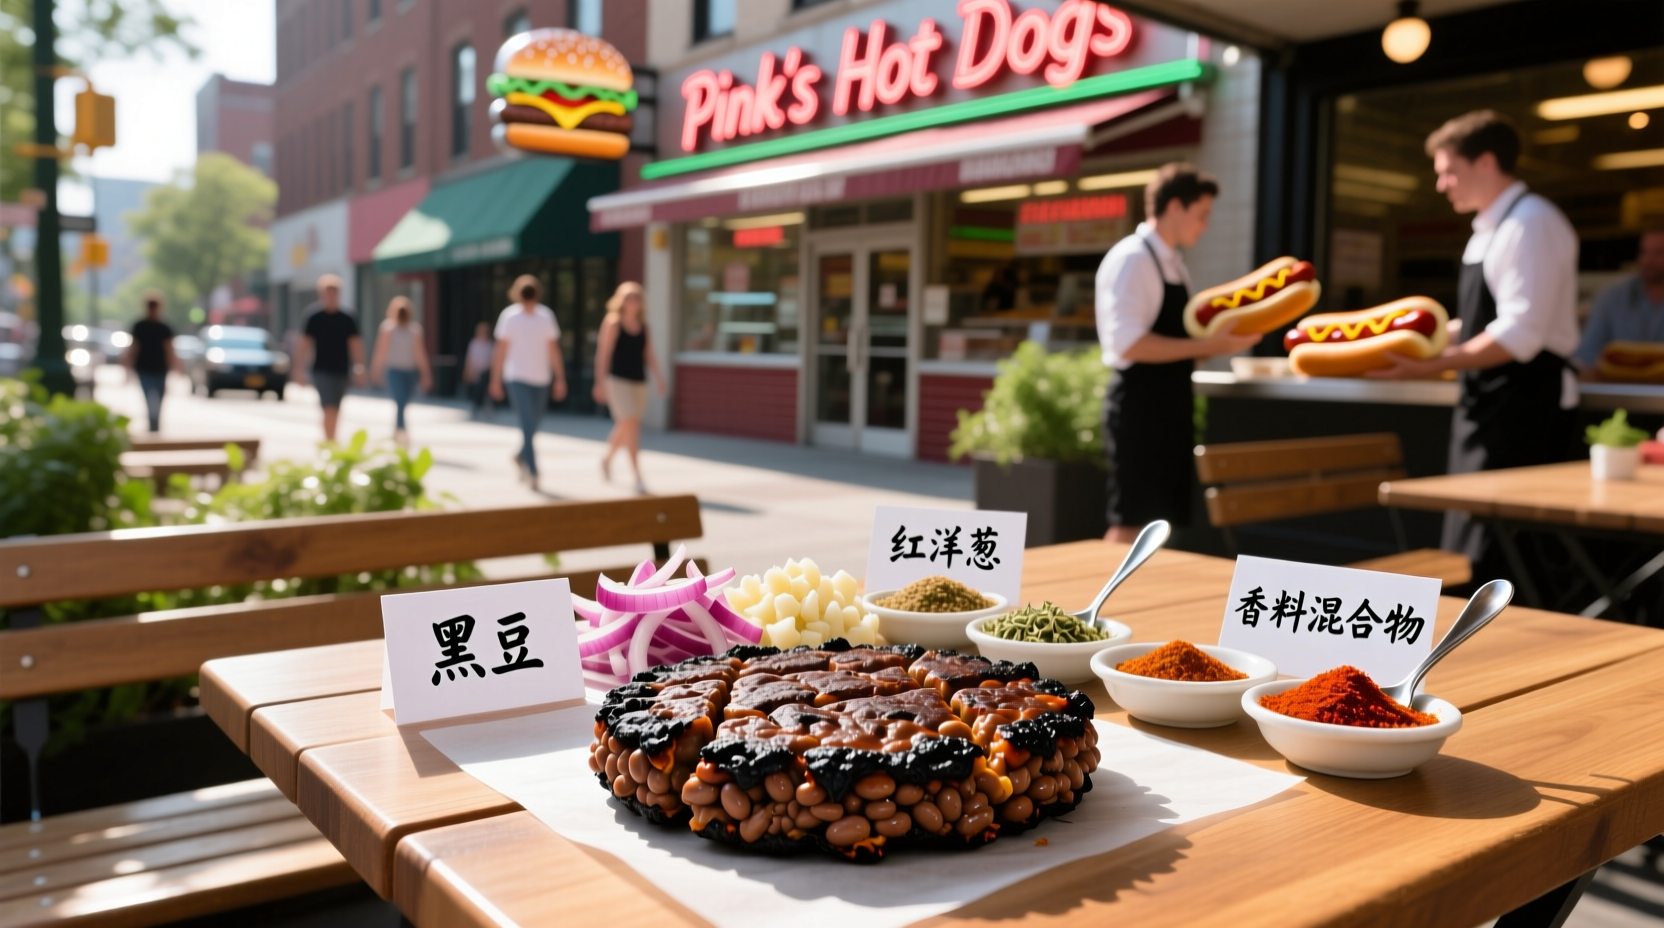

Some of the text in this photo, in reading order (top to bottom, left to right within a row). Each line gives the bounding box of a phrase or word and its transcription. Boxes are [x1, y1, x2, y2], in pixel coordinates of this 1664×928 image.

[681, 0, 1132, 152] Pink's Hot Dogs
[889, 524, 1001, 571] 红洋葱
[431, 611, 545, 687] 黑豆
[1234, 586, 1425, 645] 香料混合物
